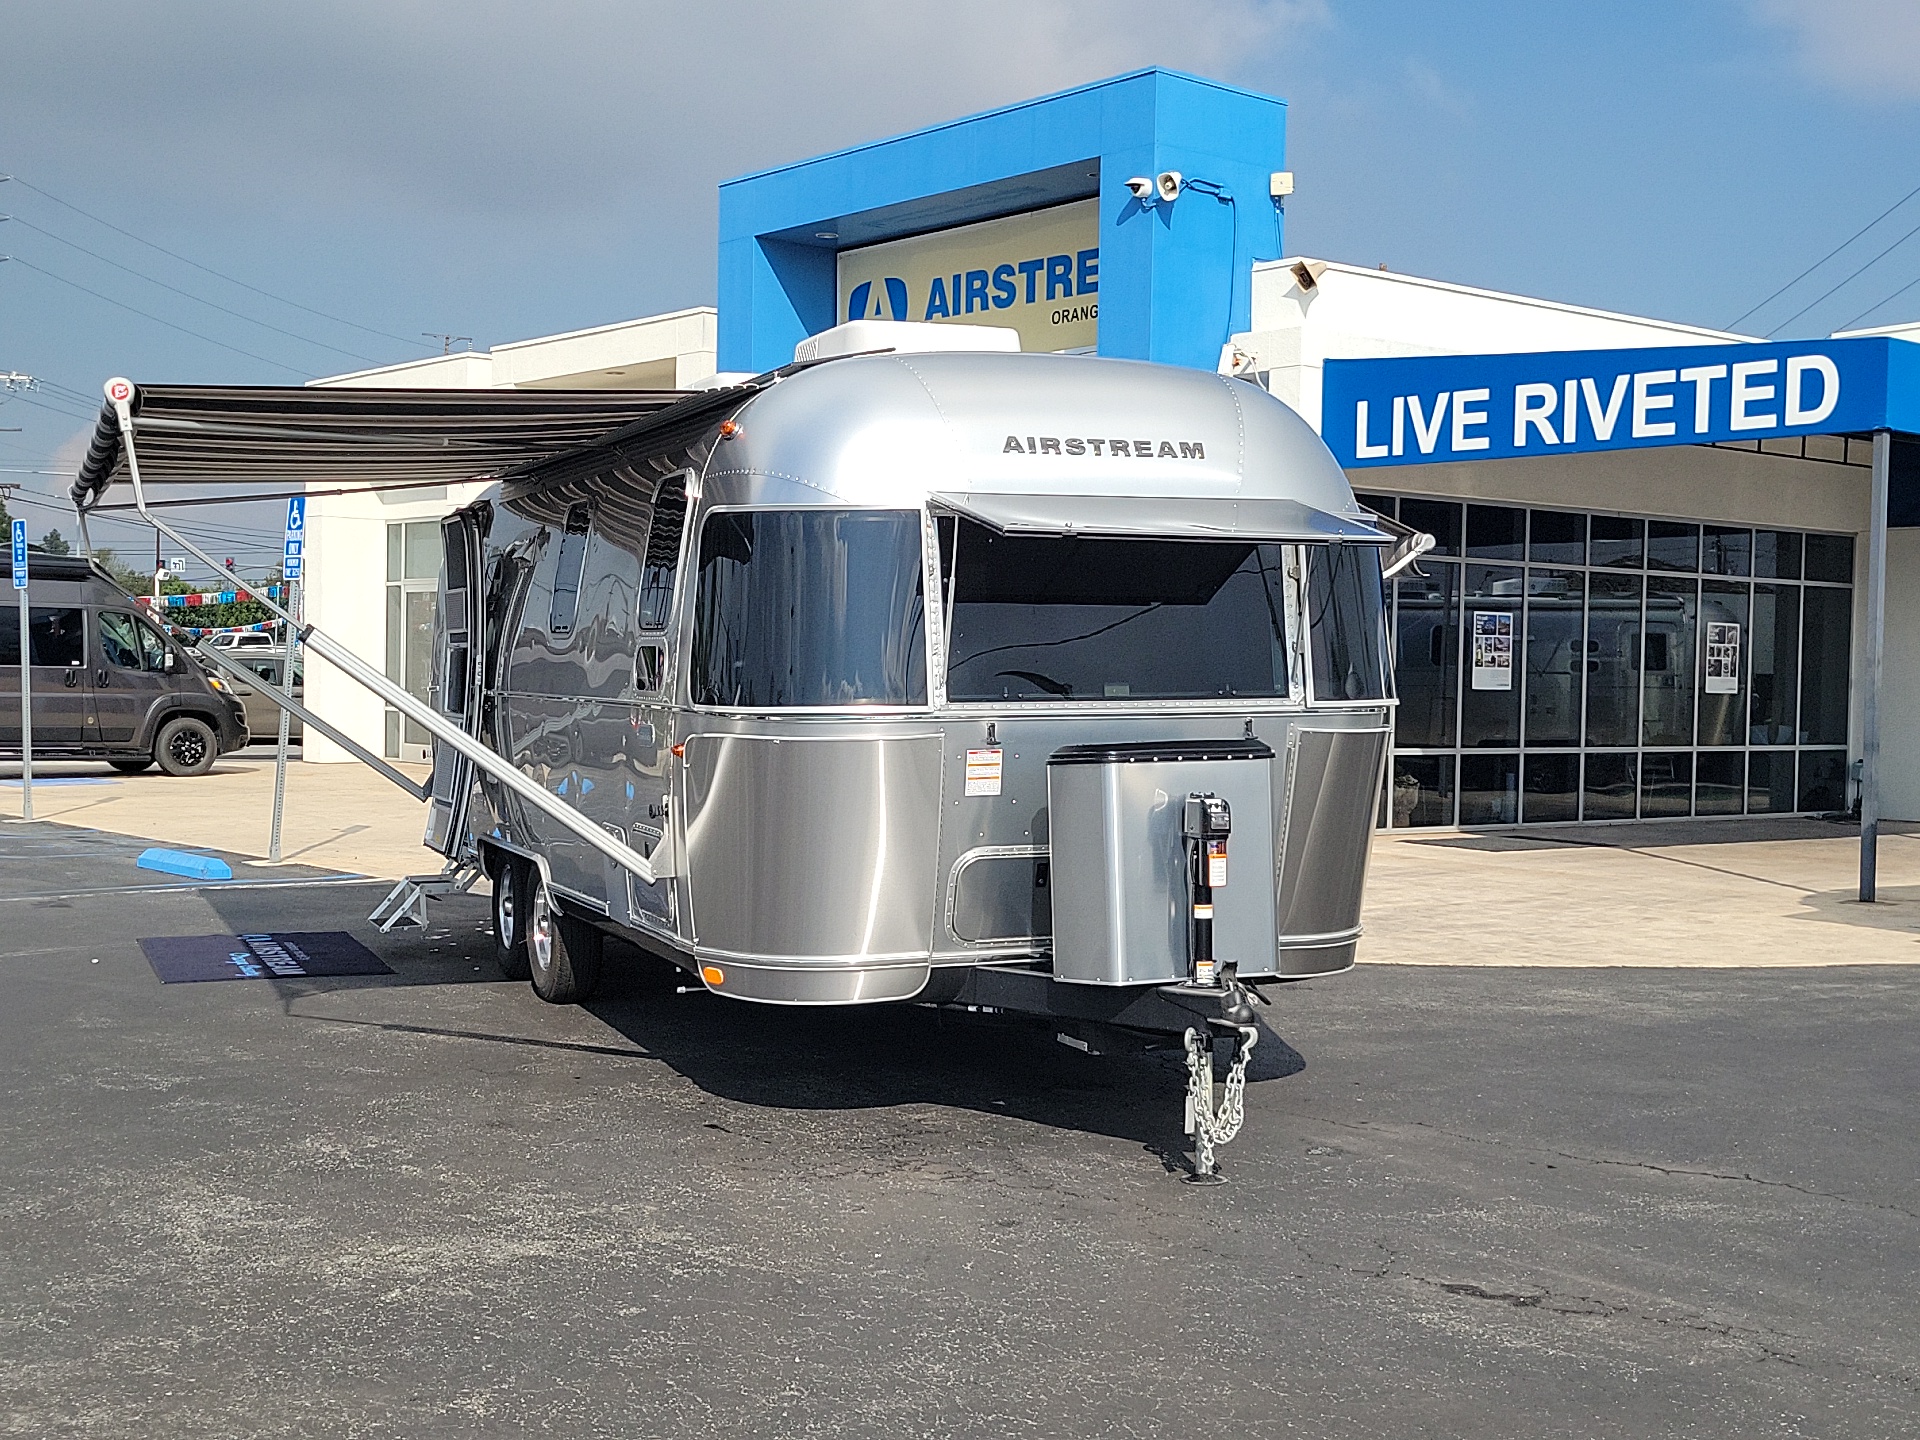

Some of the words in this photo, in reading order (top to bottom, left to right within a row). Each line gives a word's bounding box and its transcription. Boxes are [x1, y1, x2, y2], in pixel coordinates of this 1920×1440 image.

[924, 247, 1099, 321] AIRSTRE
[1051, 304, 1099, 325] ORANG
[1355, 388, 1490, 459] LIVE
[1513, 354, 1840, 447] RIVETED
[1003, 435, 1205, 459] AIRSTREAM
